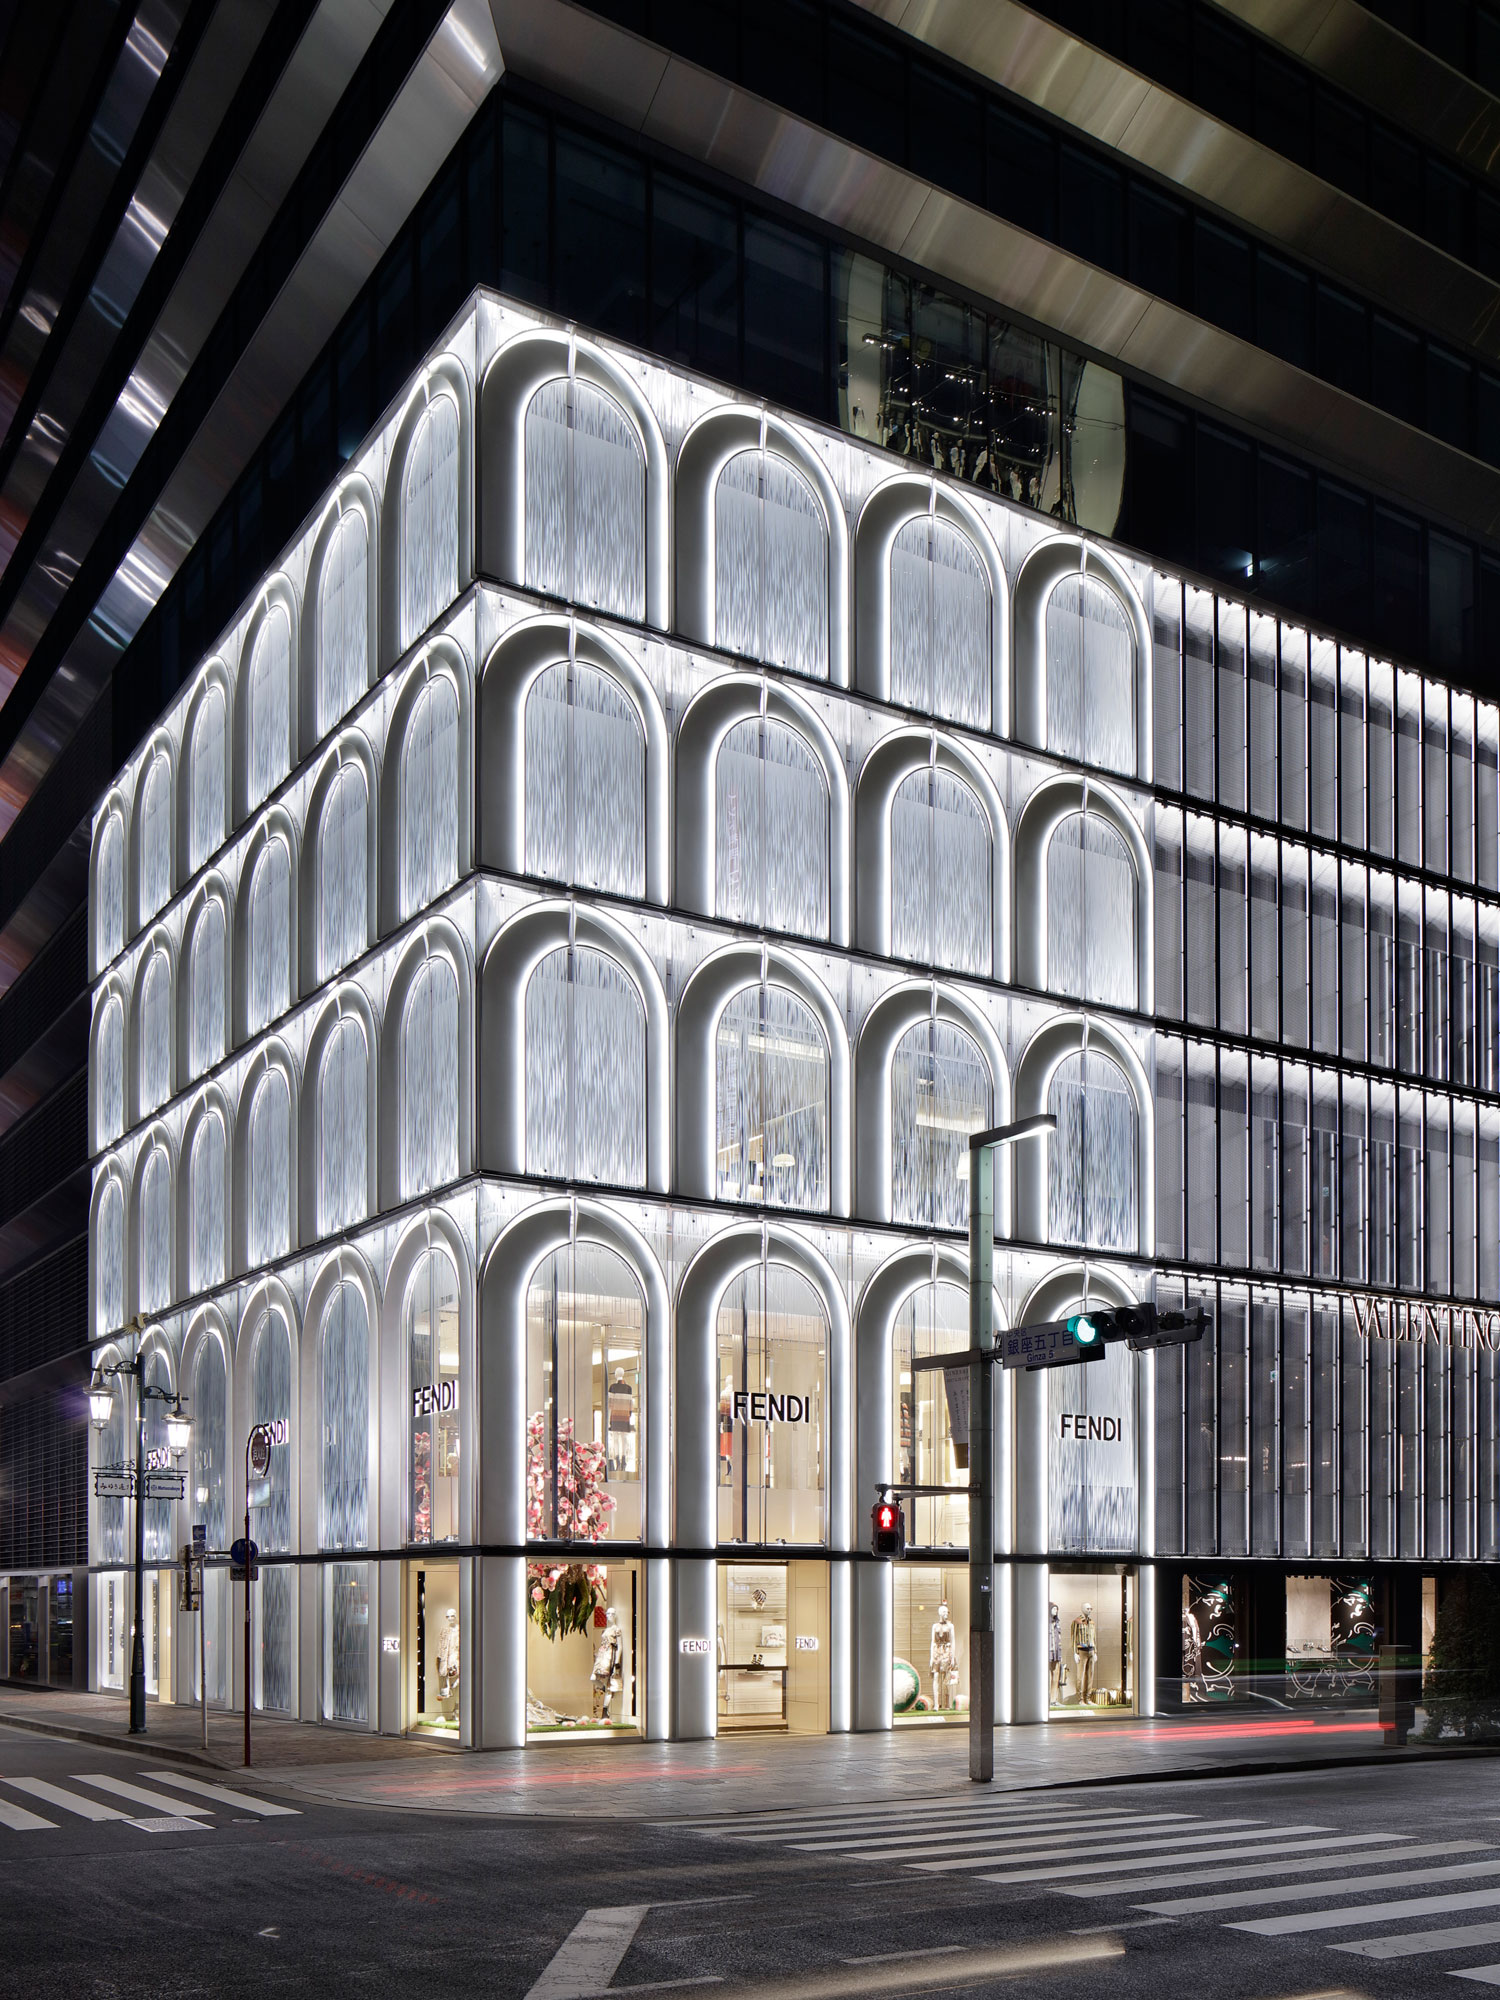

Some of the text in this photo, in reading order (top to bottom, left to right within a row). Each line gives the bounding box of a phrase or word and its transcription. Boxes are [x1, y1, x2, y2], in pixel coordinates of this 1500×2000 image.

[1351, 1295, 1500, 1352] VALENTINO
[1007, 1330, 1074, 1356] 銀座五丁目
[1026, 1350, 1054, 1362] Ginza 5
[412, 1379, 458, 1417] FENDI
[733, 1391, 810, 1424] FENDI
[257, 1419, 289, 1447] ENDI
[1060, 1413, 1122, 1442] FENDI
[382, 1637, 400, 1651] FENDI
[681, 1640, 711, 1652] FENDI
[795, 1637, 817, 1649] FENDI
